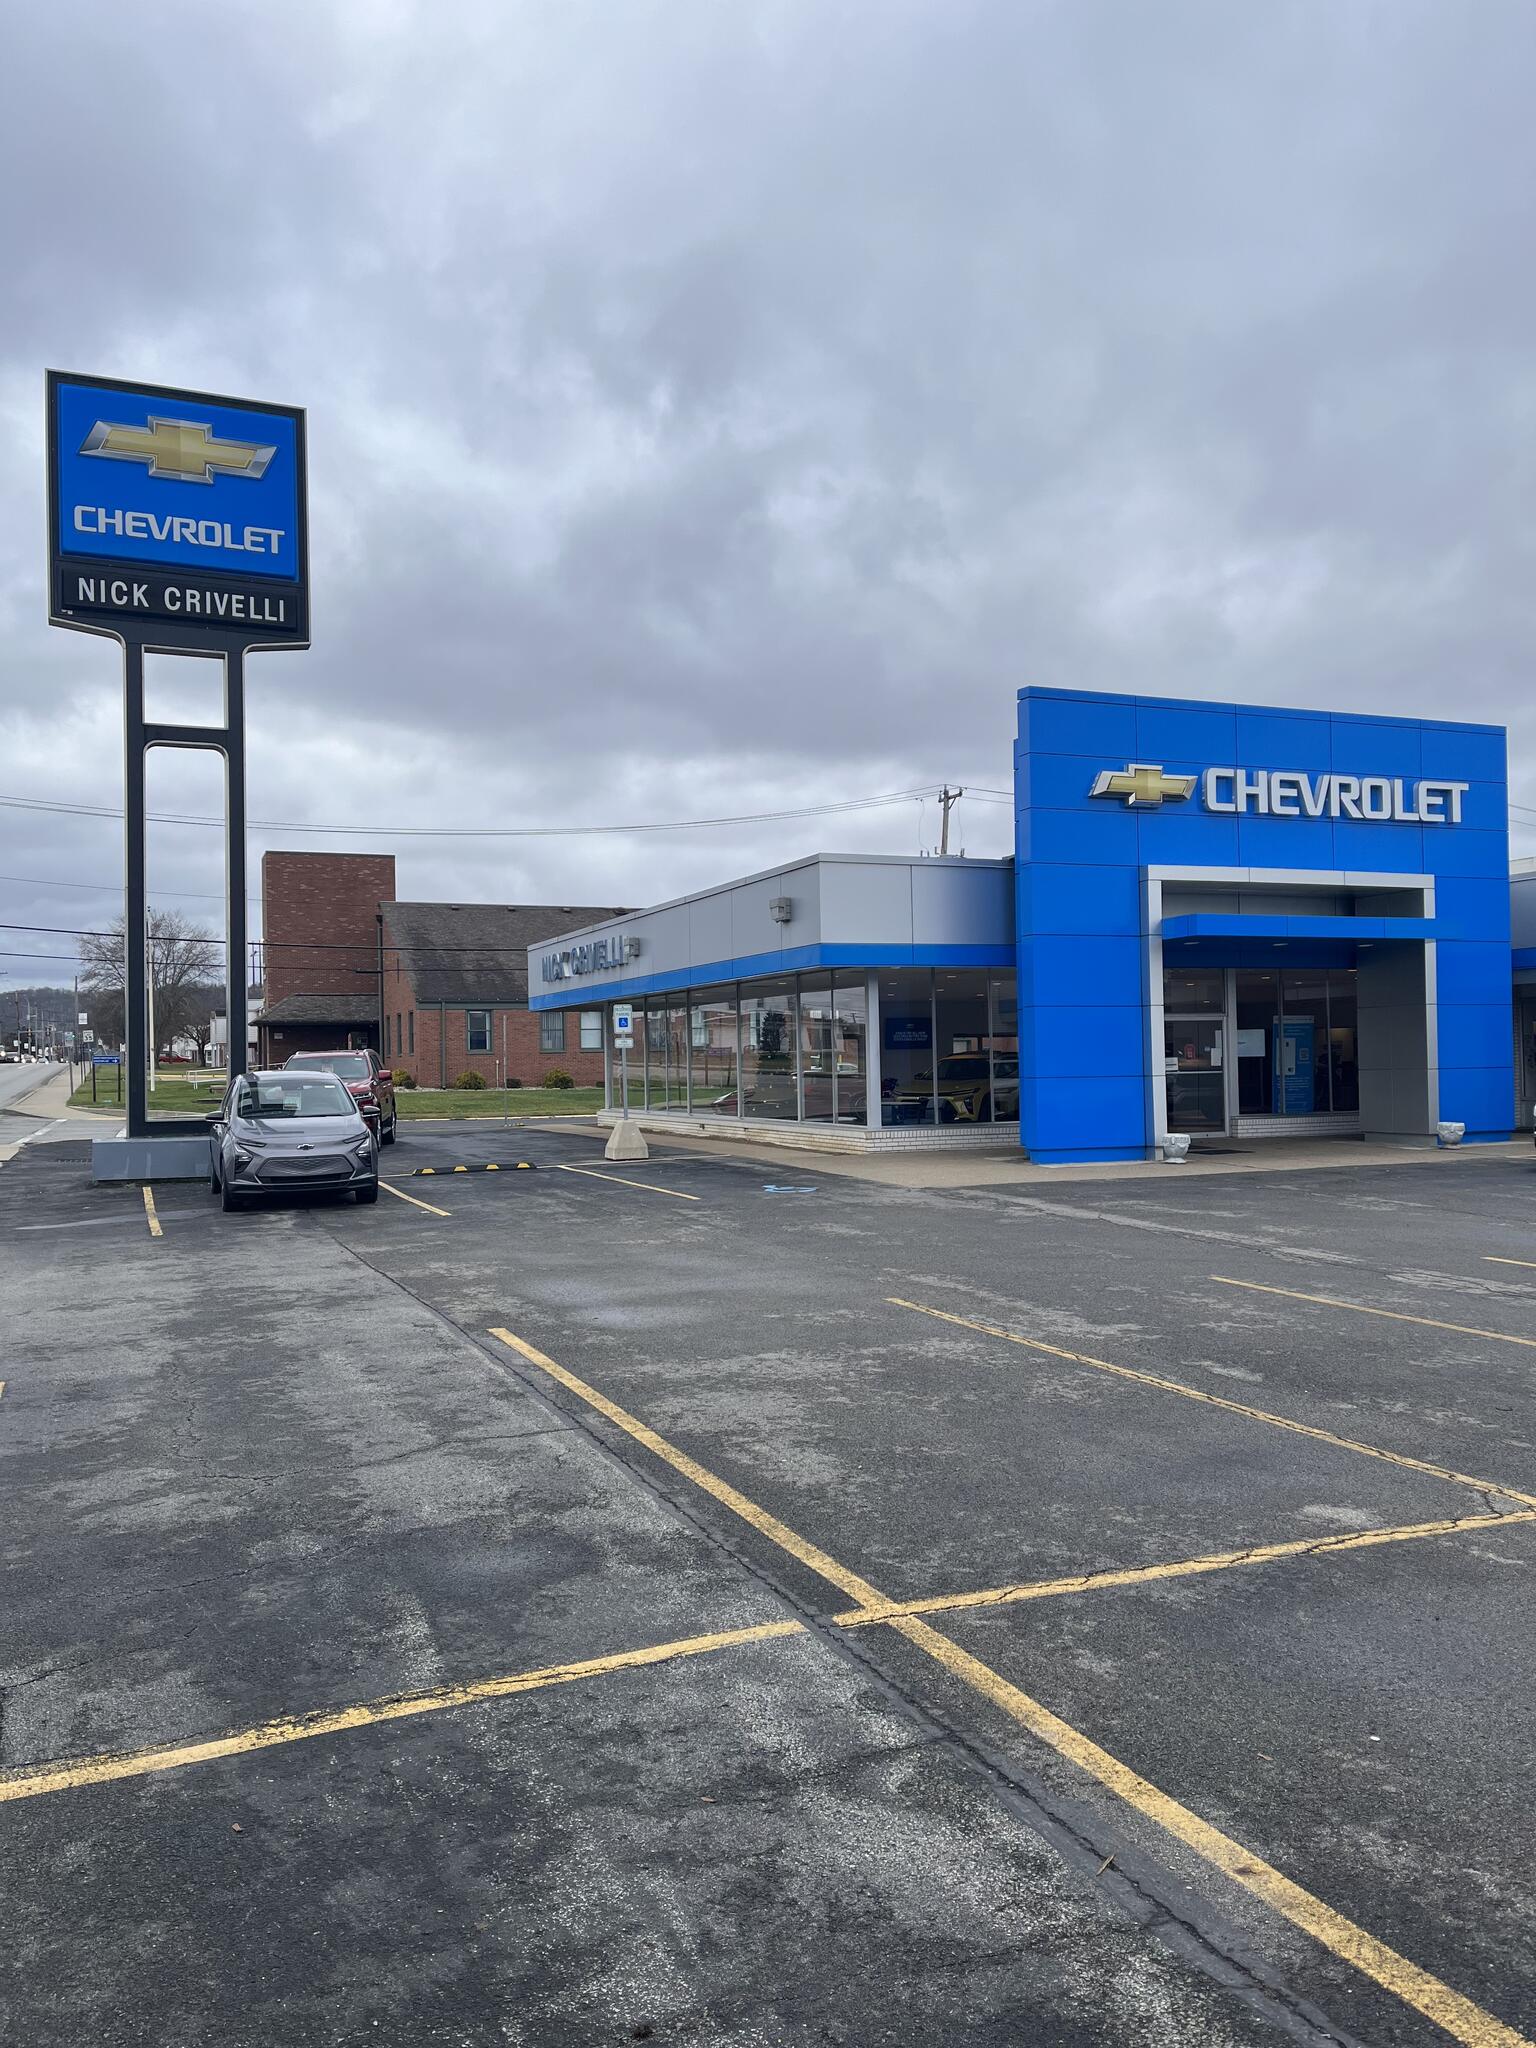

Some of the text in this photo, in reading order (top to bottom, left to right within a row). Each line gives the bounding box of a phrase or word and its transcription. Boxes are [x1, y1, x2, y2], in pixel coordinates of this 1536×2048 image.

[73, 505, 285, 554] CHEVROLET
[78, 577, 285, 622] NICK CRIVELLI
[1202, 767, 1469, 823] CHEVROLET
[571, 935, 624, 975] CRIVELLI
